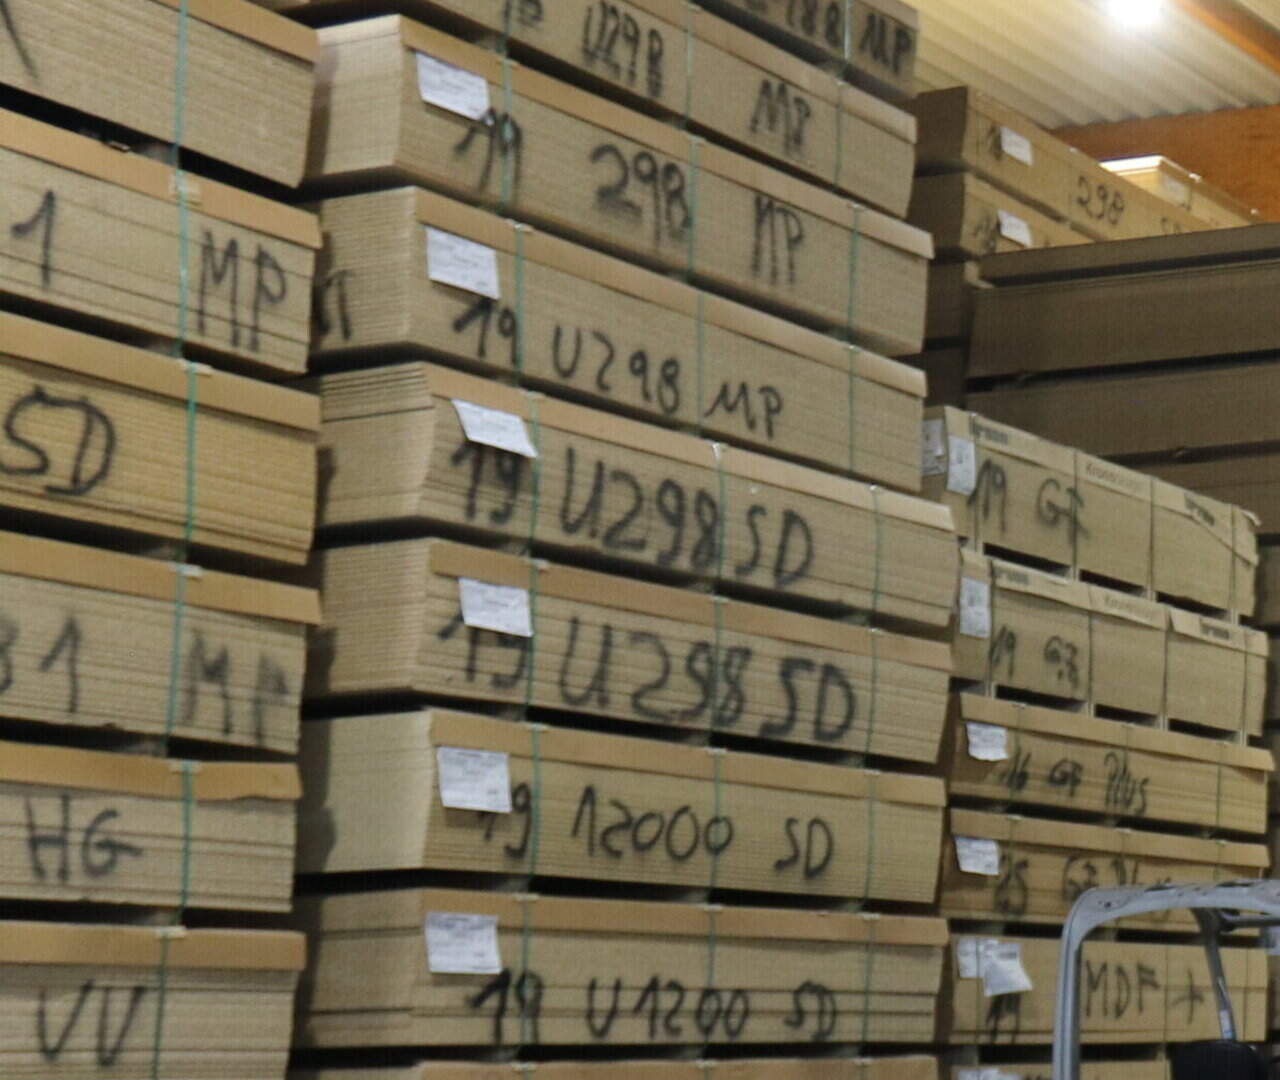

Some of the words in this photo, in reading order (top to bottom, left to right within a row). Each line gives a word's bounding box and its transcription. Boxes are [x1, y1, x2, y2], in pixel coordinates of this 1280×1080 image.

[197, 230, 288, 354] MP
[550, 323, 683, 417] U298
[703, 379, 784, 440] MP
[558, 444, 720, 573] U298
[733, 503, 817, 590] SD
[558, 614, 754, 728] U298
[758, 655, 857, 742] SD
[25, 791, 145, 884] HG
[570, 784, 733, 862] 12000
[773, 815, 834, 879] SD
[585, 973, 753, 1042] U1200
[783, 978, 839, 1042] SD
